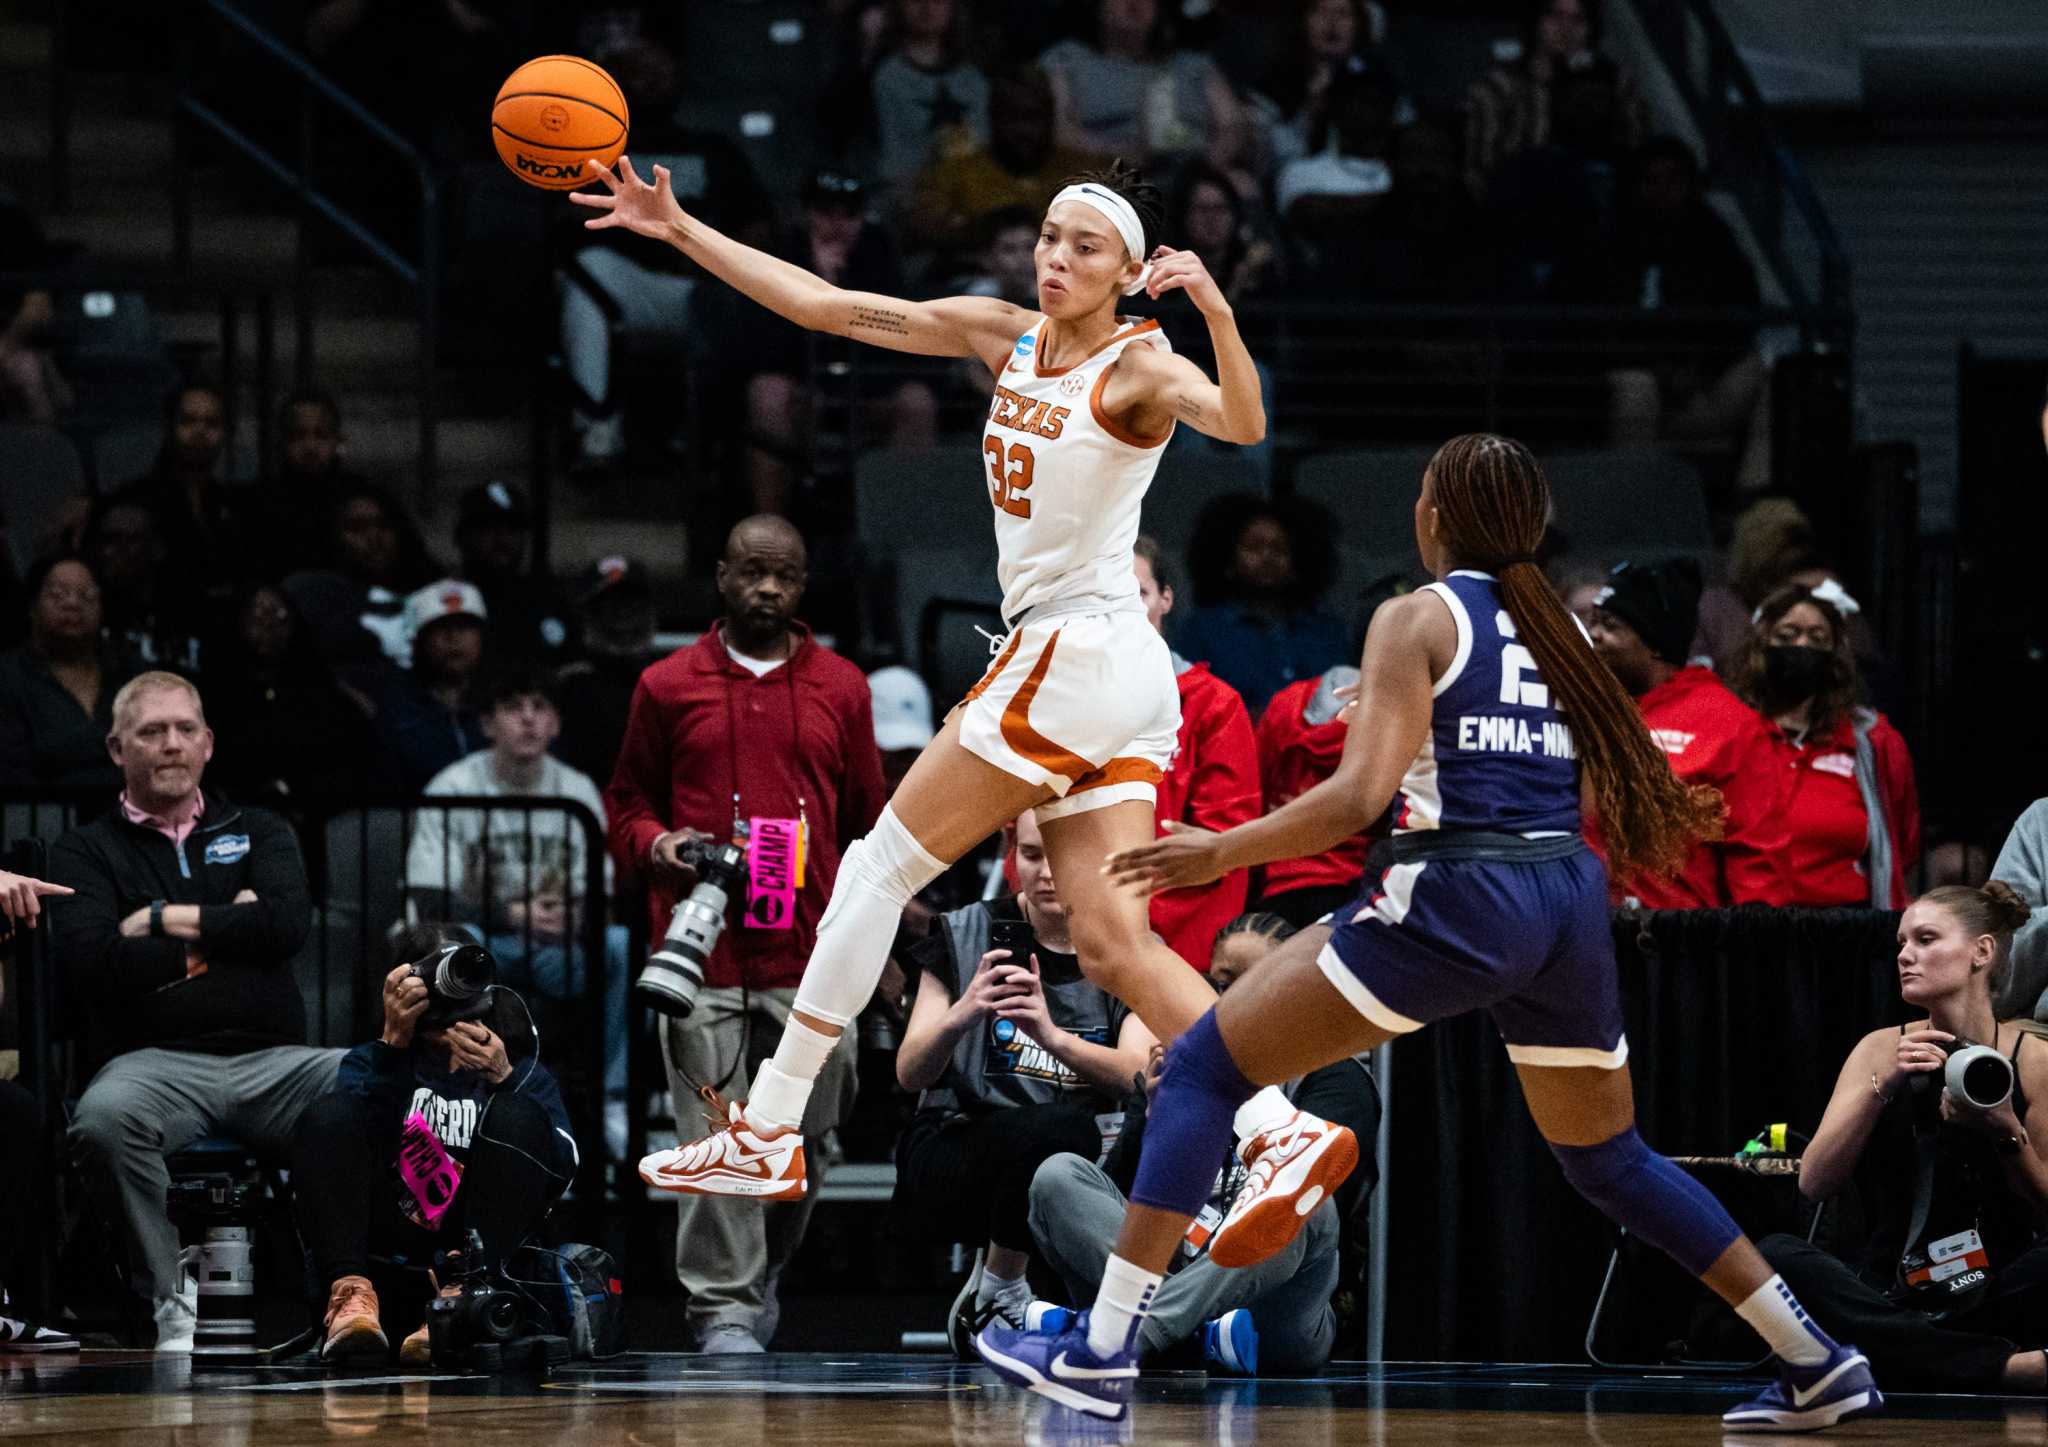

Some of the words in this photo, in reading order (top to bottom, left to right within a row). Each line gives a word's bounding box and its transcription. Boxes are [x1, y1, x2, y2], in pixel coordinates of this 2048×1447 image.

[516, 153, 583, 179] NCAA
[988, 385, 1071, 440] TEXAS
[984, 434, 1035, 519] 32
[1495, 609, 1567, 712] 2
[1949, 1270, 1985, 1292] SONY
